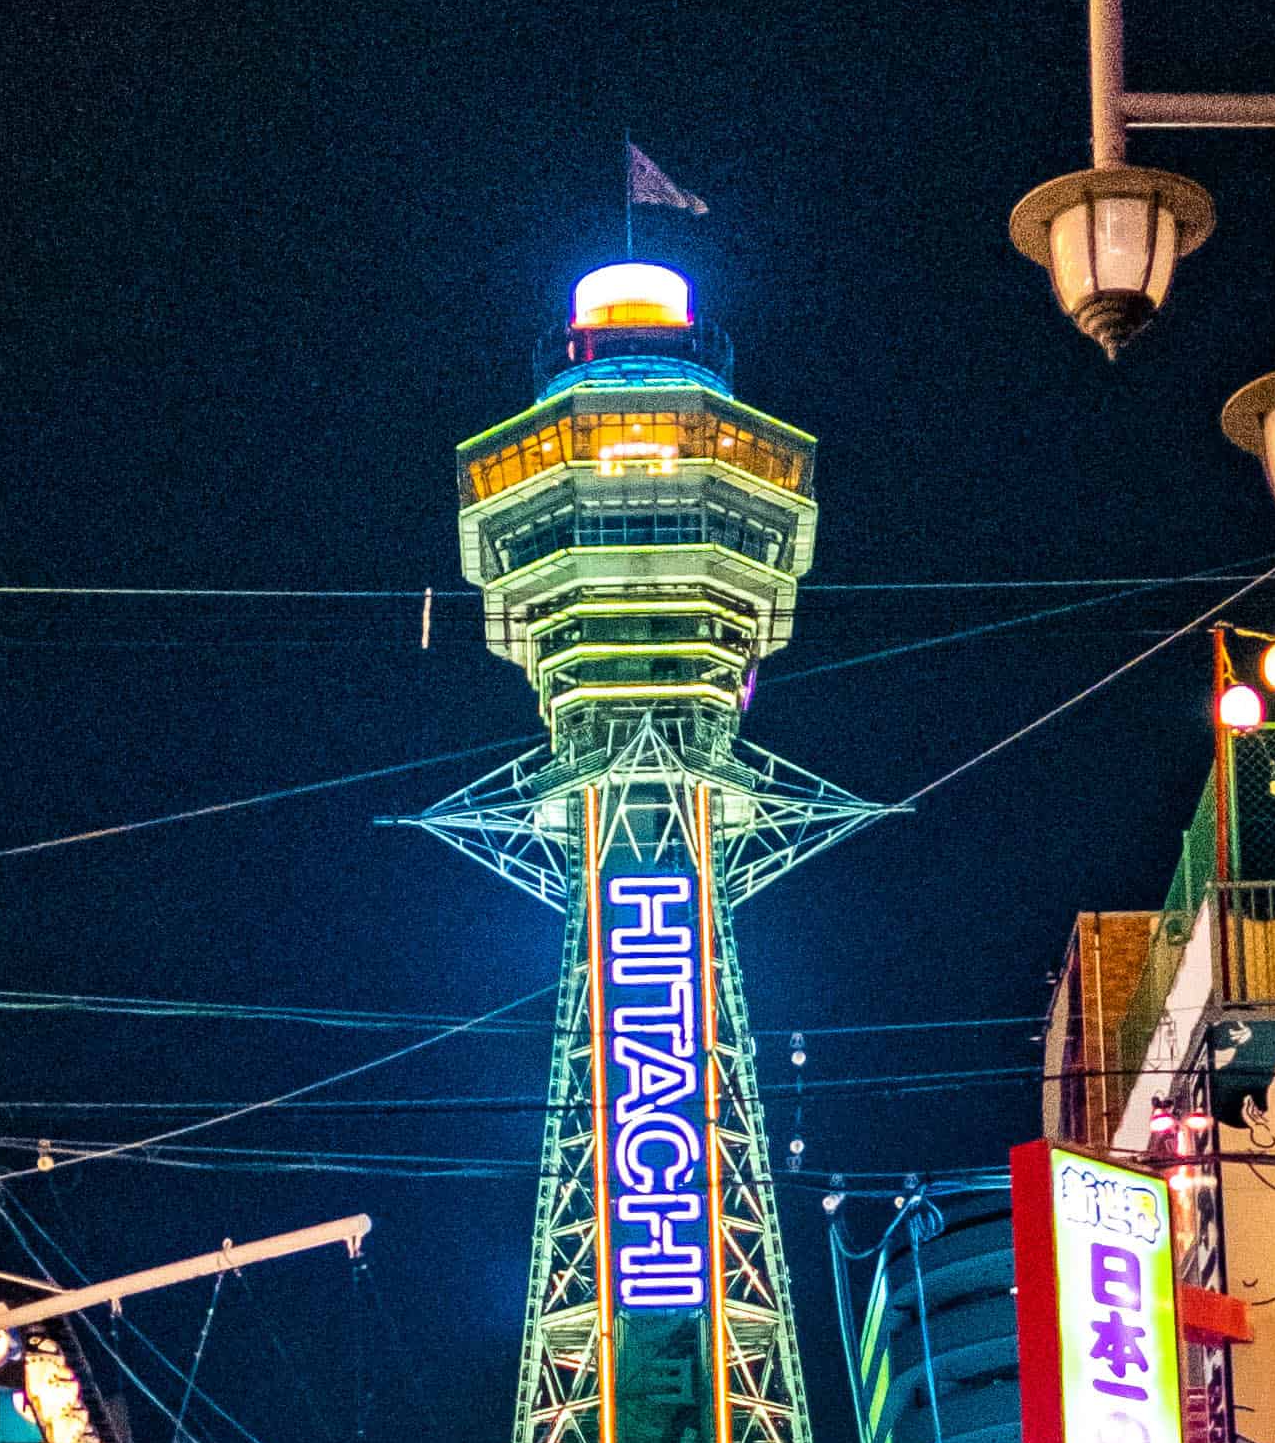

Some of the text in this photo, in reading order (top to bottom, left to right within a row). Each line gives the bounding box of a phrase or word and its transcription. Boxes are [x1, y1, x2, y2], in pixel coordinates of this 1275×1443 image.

[606, 874, 704, 1307] HITACHI
[1061, 1165, 1163, 1247] 新世界
